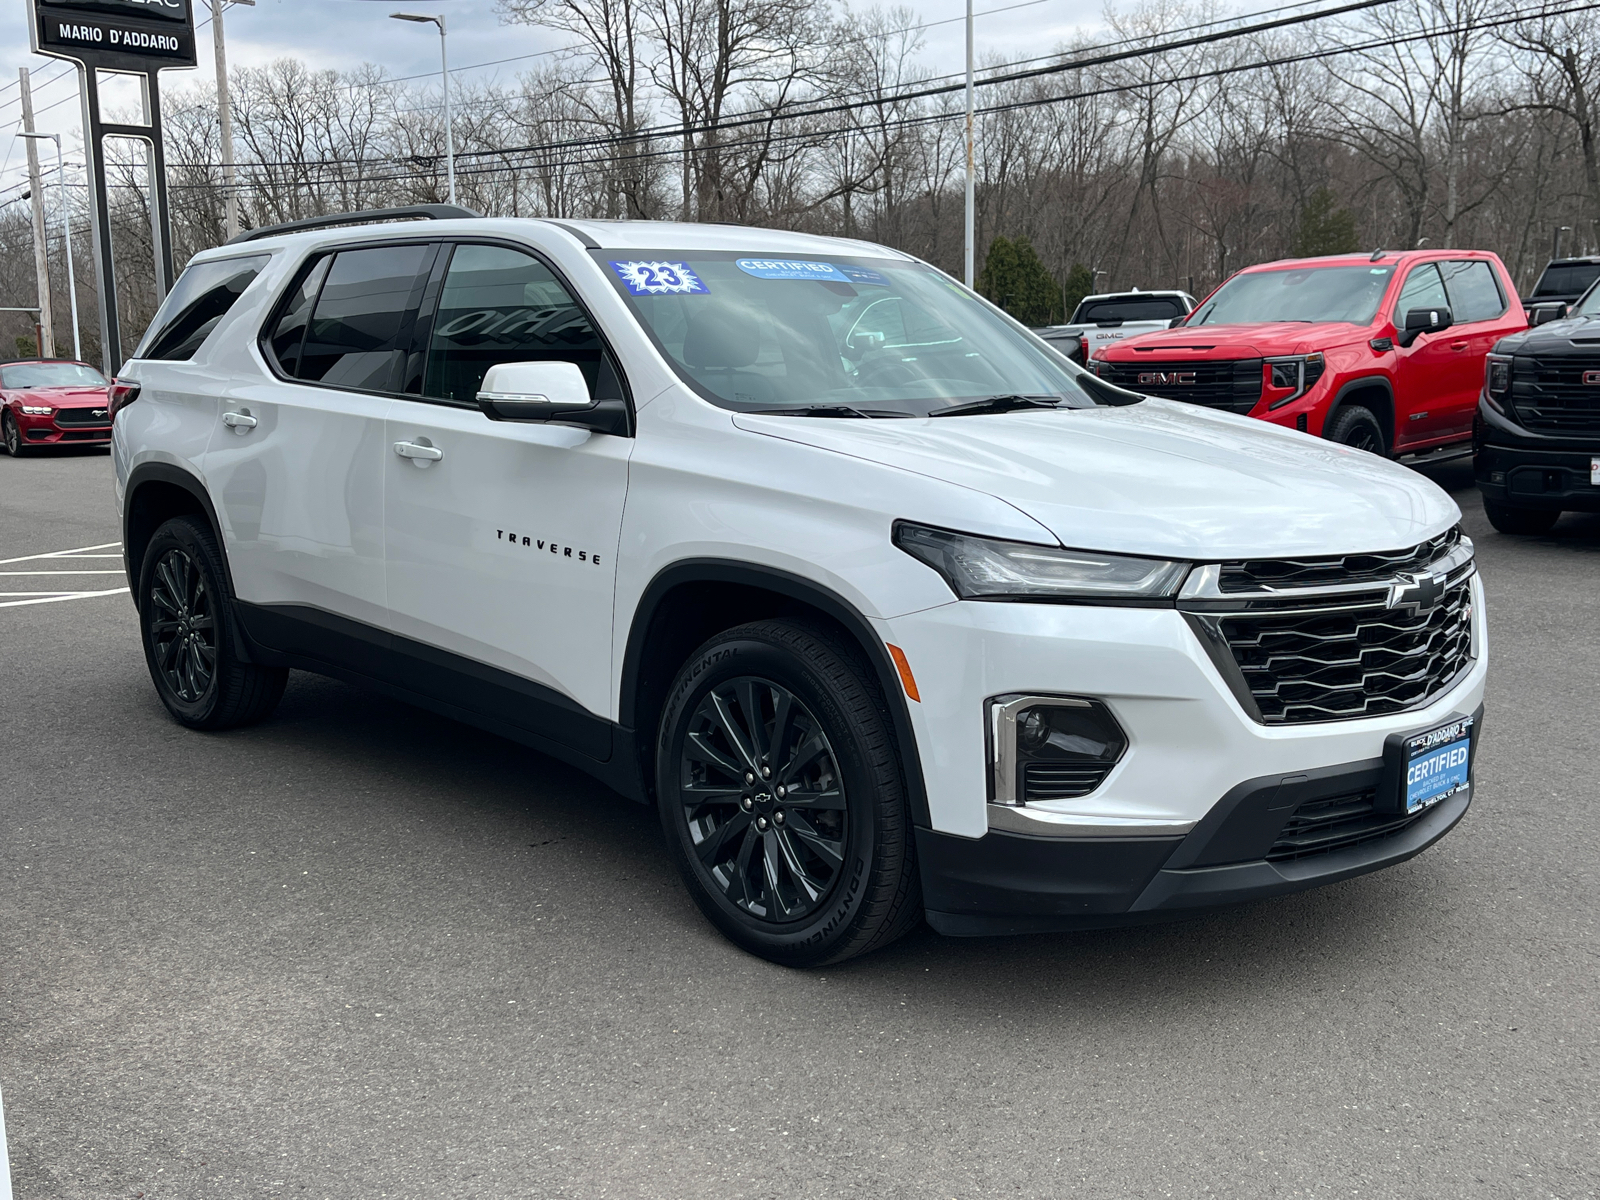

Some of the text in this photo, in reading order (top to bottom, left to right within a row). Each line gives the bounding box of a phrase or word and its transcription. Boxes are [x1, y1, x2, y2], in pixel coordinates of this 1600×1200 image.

[59, 23, 178, 51] MARIO D'ADDARIO
[636, 266, 683, 287] 23
[740, 260, 834, 273] CERTIFIED
[1096, 332, 1124, 340] GMC
[1137, 371, 1197, 386] GMC
[496, 529, 601, 566] TRAVERSE
[661, 647, 742, 751] CONTINENTAL
[1427, 724, 1460, 746] D'ADDARIO
[1407, 747, 1466, 785] CERTIFIED
